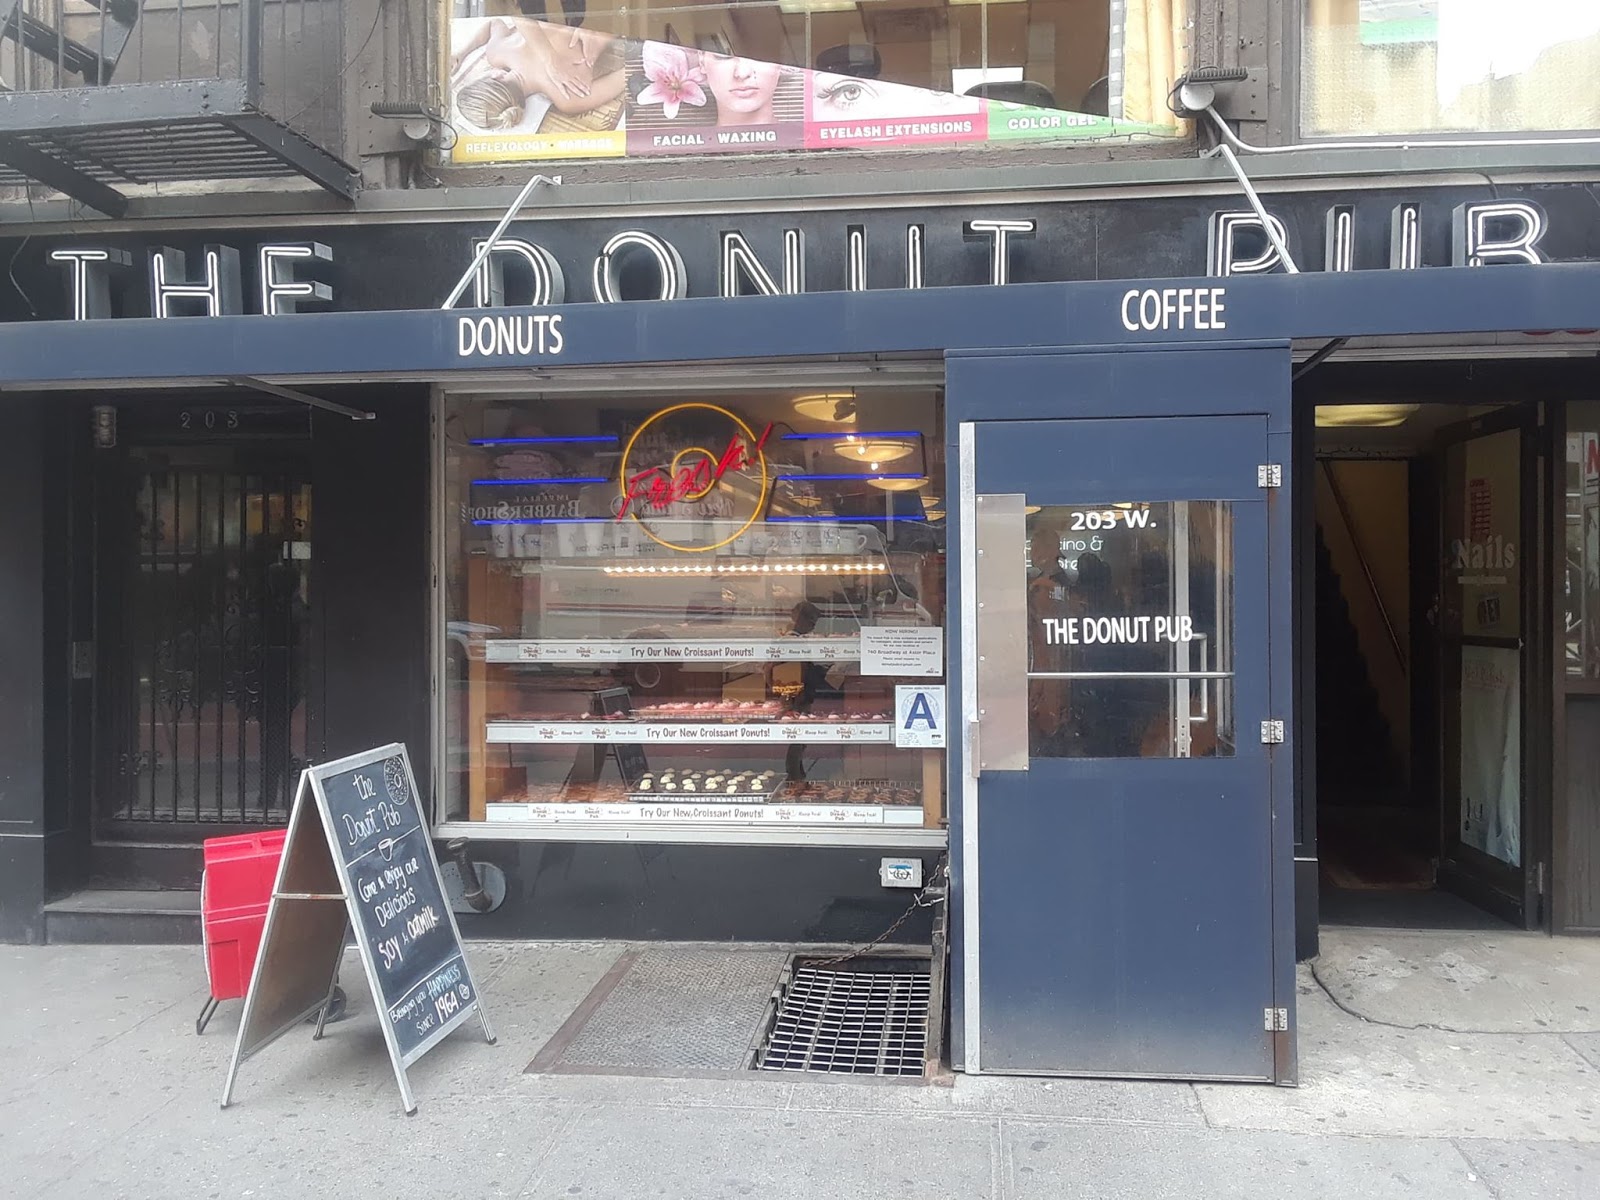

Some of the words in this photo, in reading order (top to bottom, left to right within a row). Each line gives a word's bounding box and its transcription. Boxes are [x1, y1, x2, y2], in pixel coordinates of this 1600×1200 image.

[820, 126, 882, 140] EYELASH
[886, 121, 972, 136] EXTENSIONS
[1008, 116, 1062, 130] COLOR
[1066, 116, 1097, 126] GEL
[465, 140, 547, 154] REFLEXOLOGY
[653, 134, 704, 146] FACIAL
[718, 131, 776, 144] WAXING
[46, 241, 333, 321] THE
[472, 219, 1037, 307] DONUT
[1198, 199, 1548, 277] PUB
[1121, 287, 1226, 332] COFFEE
[458, 314, 564, 358] DONUTS
[180, 410, 238, 428] 203
[1070, 511, 1117, 531] 203
[1124, 509, 1157, 529] W.
[1456, 534, 1516, 570] Nails
[1042, 618, 1079, 645] THE
[1083, 616, 1150, 644] DONUT
[1154, 616, 1193, 642] PUB
[631, 647, 644, 658] Try
[648, 646, 662, 656] Our
[664, 646, 682, 656] New
[684, 646, 722, 657] Croissant
[725, 646, 754, 657] Donuts!
[904, 692, 937, 729] A
[646, 728, 660, 739] Try
[663, 728, 677, 738] Our
[680, 728, 697, 737] New
[700, 728, 738, 738] Croissant
[741, 728, 770, 738] Donuts!
[640, 808, 653, 819] Try
[657, 808, 670, 817] Our
[694, 808, 732, 818] Croissant
[735, 808, 764, 818] Donuts!
[342, 808, 380, 846] Donut
[378, 802, 401, 830] Pub
